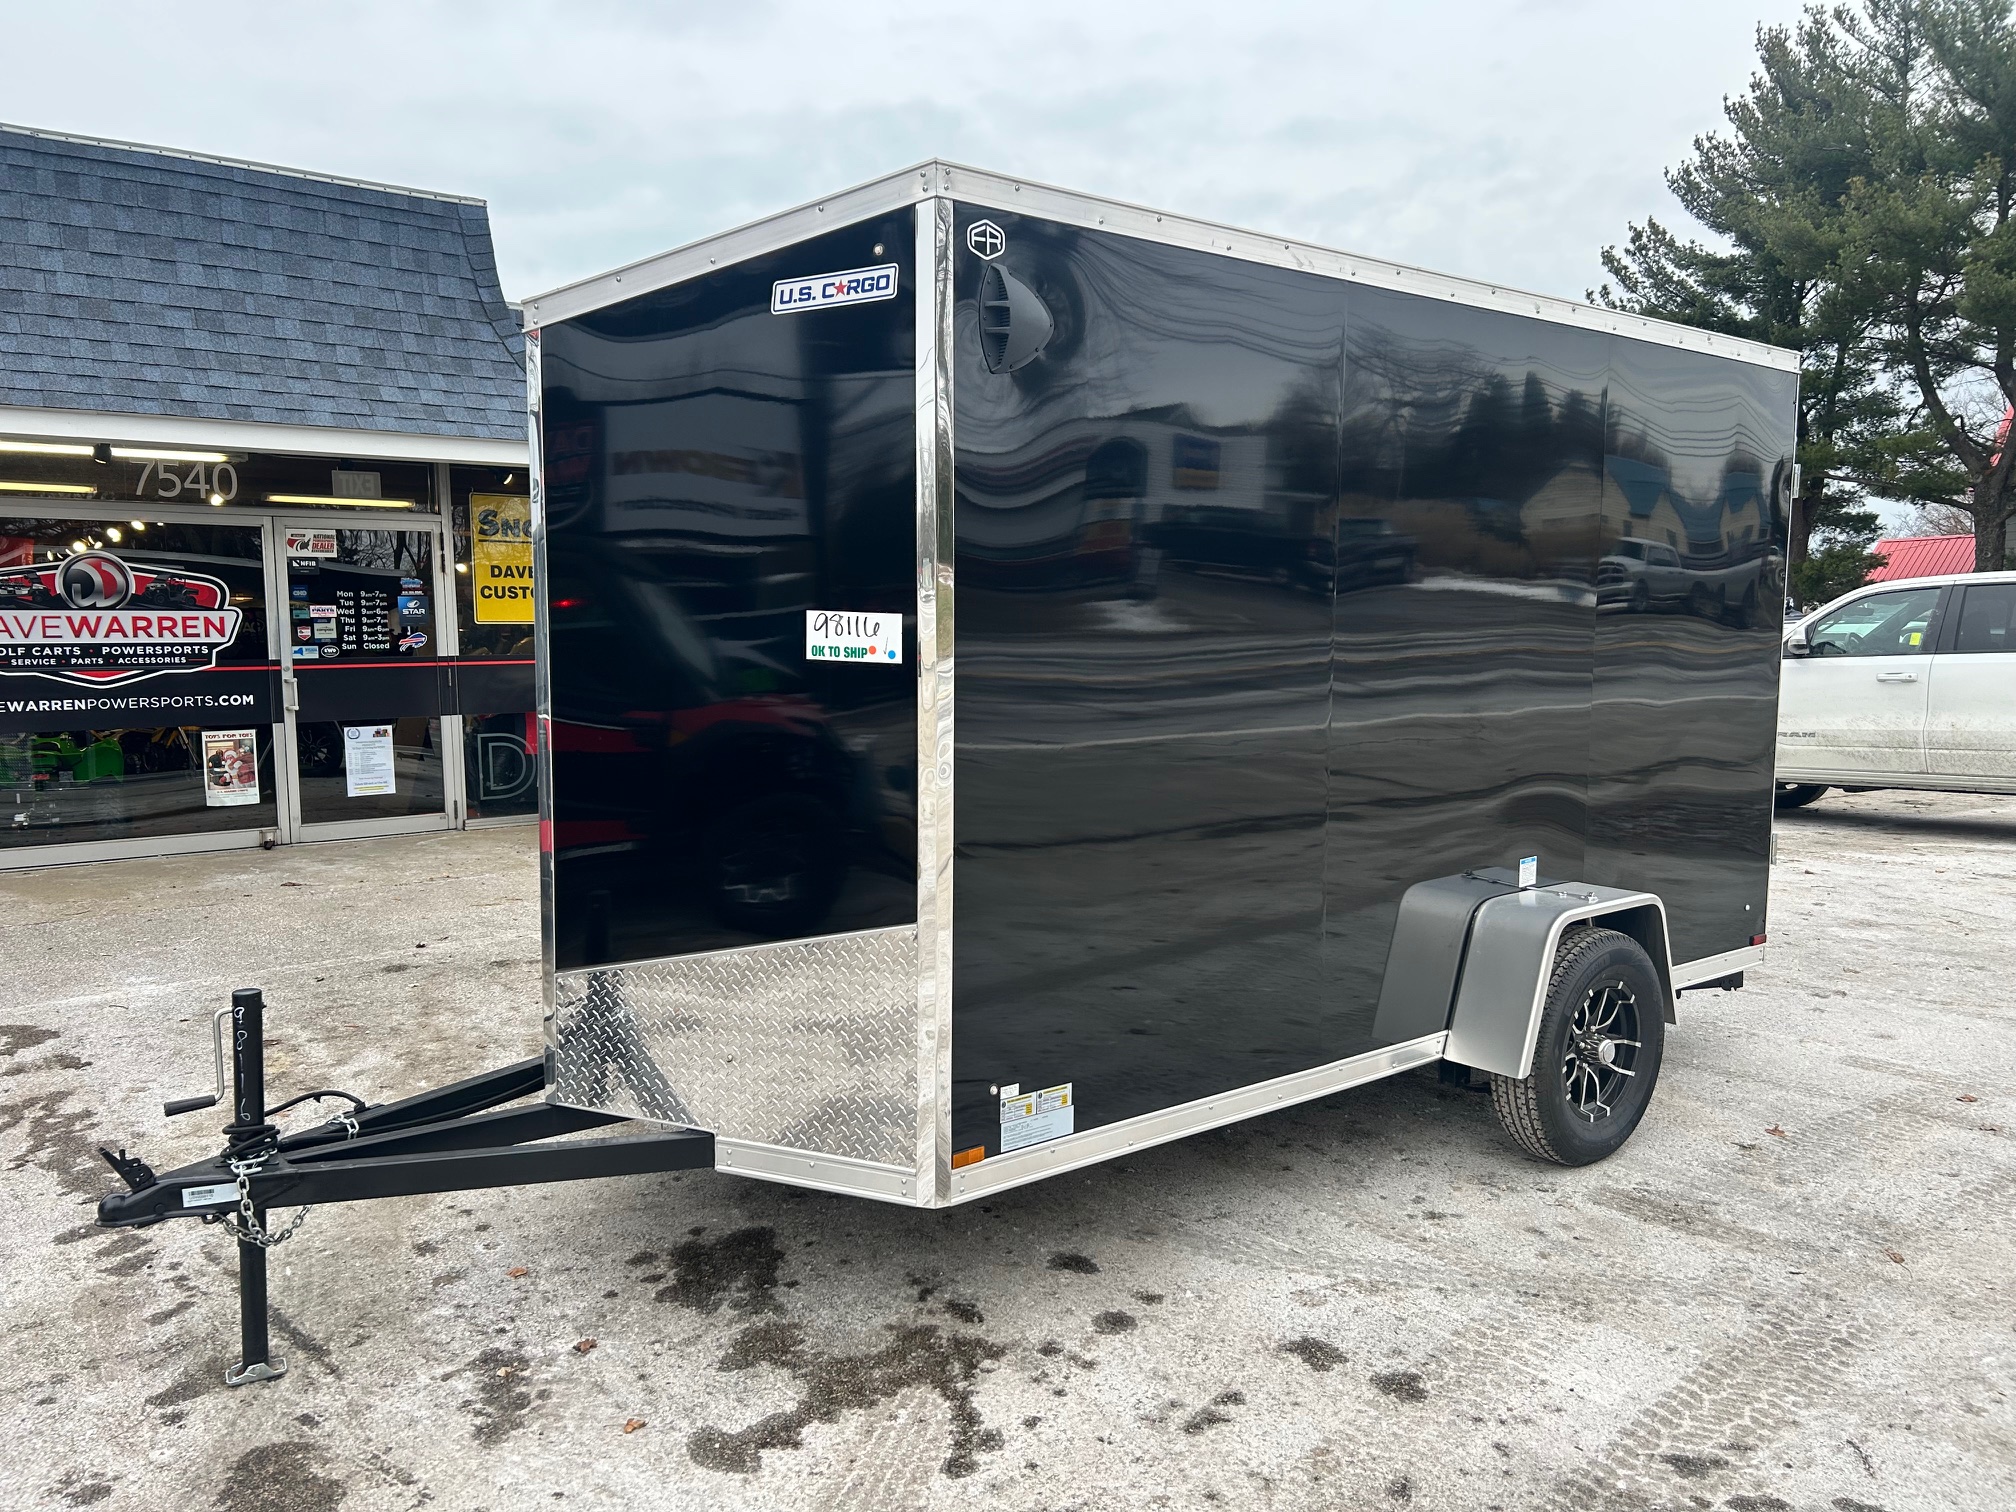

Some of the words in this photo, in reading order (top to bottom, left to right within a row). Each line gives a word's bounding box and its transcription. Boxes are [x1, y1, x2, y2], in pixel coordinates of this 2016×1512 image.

[780, 286, 816, 305] U.S.
[129, 460, 238, 500] 7540
[360, 590, 387, 598] 9am-7pm
[360, 599, 388, 607] 9am-7pm
[361, 608, 389, 616] 9am-6pm
[361, 616, 389, 624] 9am-7pm
[362, 625, 390, 633] 9am-6pm
[813, 612, 880, 638] 98116
[32, 646, 81, 656] CARTS
[102, 645, 209, 655] POWERSPORTS
[341, 642, 357, 650] Sun
[363, 642, 390, 650] Closed
[811, 645, 826, 657] OK
[828, 646, 840, 657] TO
[844, 647, 868, 658] SHIP
[10, 658, 57, 666] SERVICE
[70, 657, 104, 665] PARTS
[117, 656, 187, 664] ACCESSORIES
